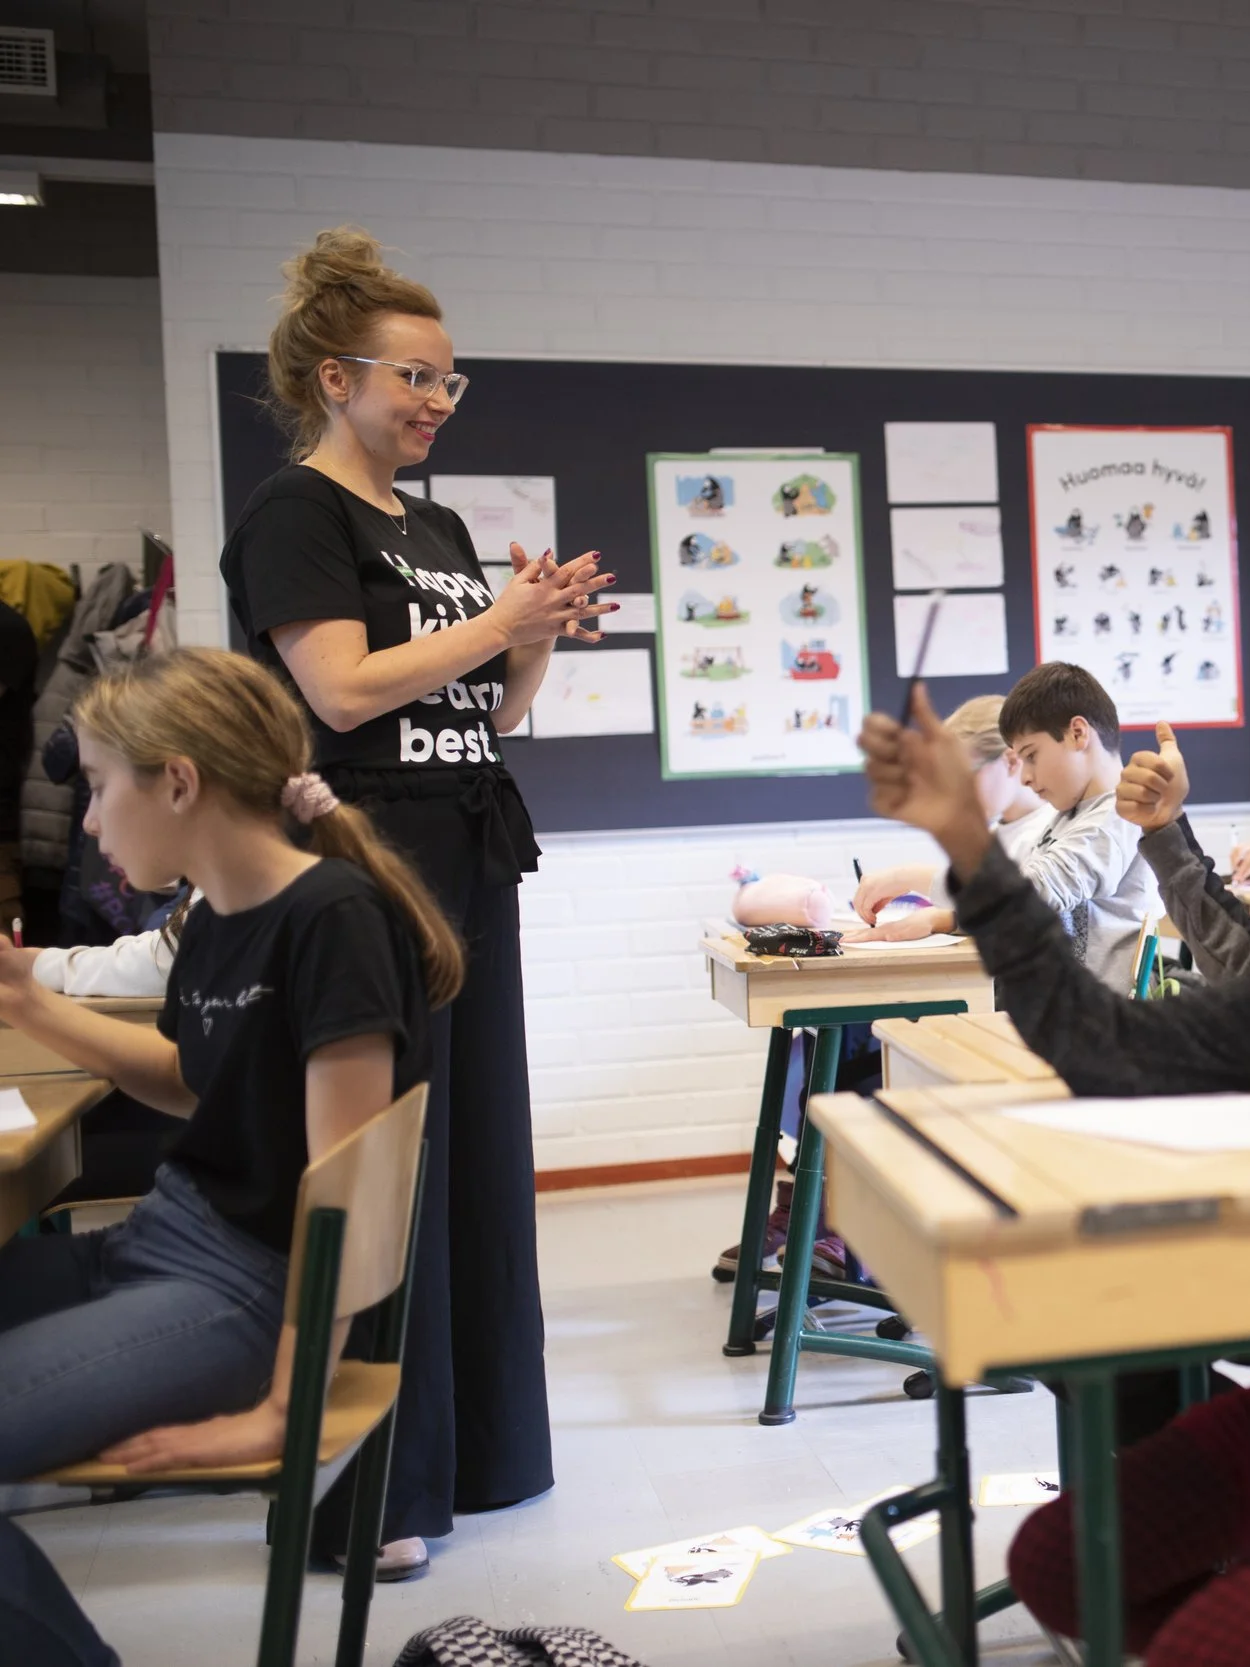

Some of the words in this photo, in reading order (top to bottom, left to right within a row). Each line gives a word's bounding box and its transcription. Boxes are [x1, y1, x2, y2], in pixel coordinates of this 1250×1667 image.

[1059, 462, 1146, 493] Huomaa
[380, 550, 496, 609] Happy
[408, 603, 468, 641] ki
[417, 680, 504, 711] earn
